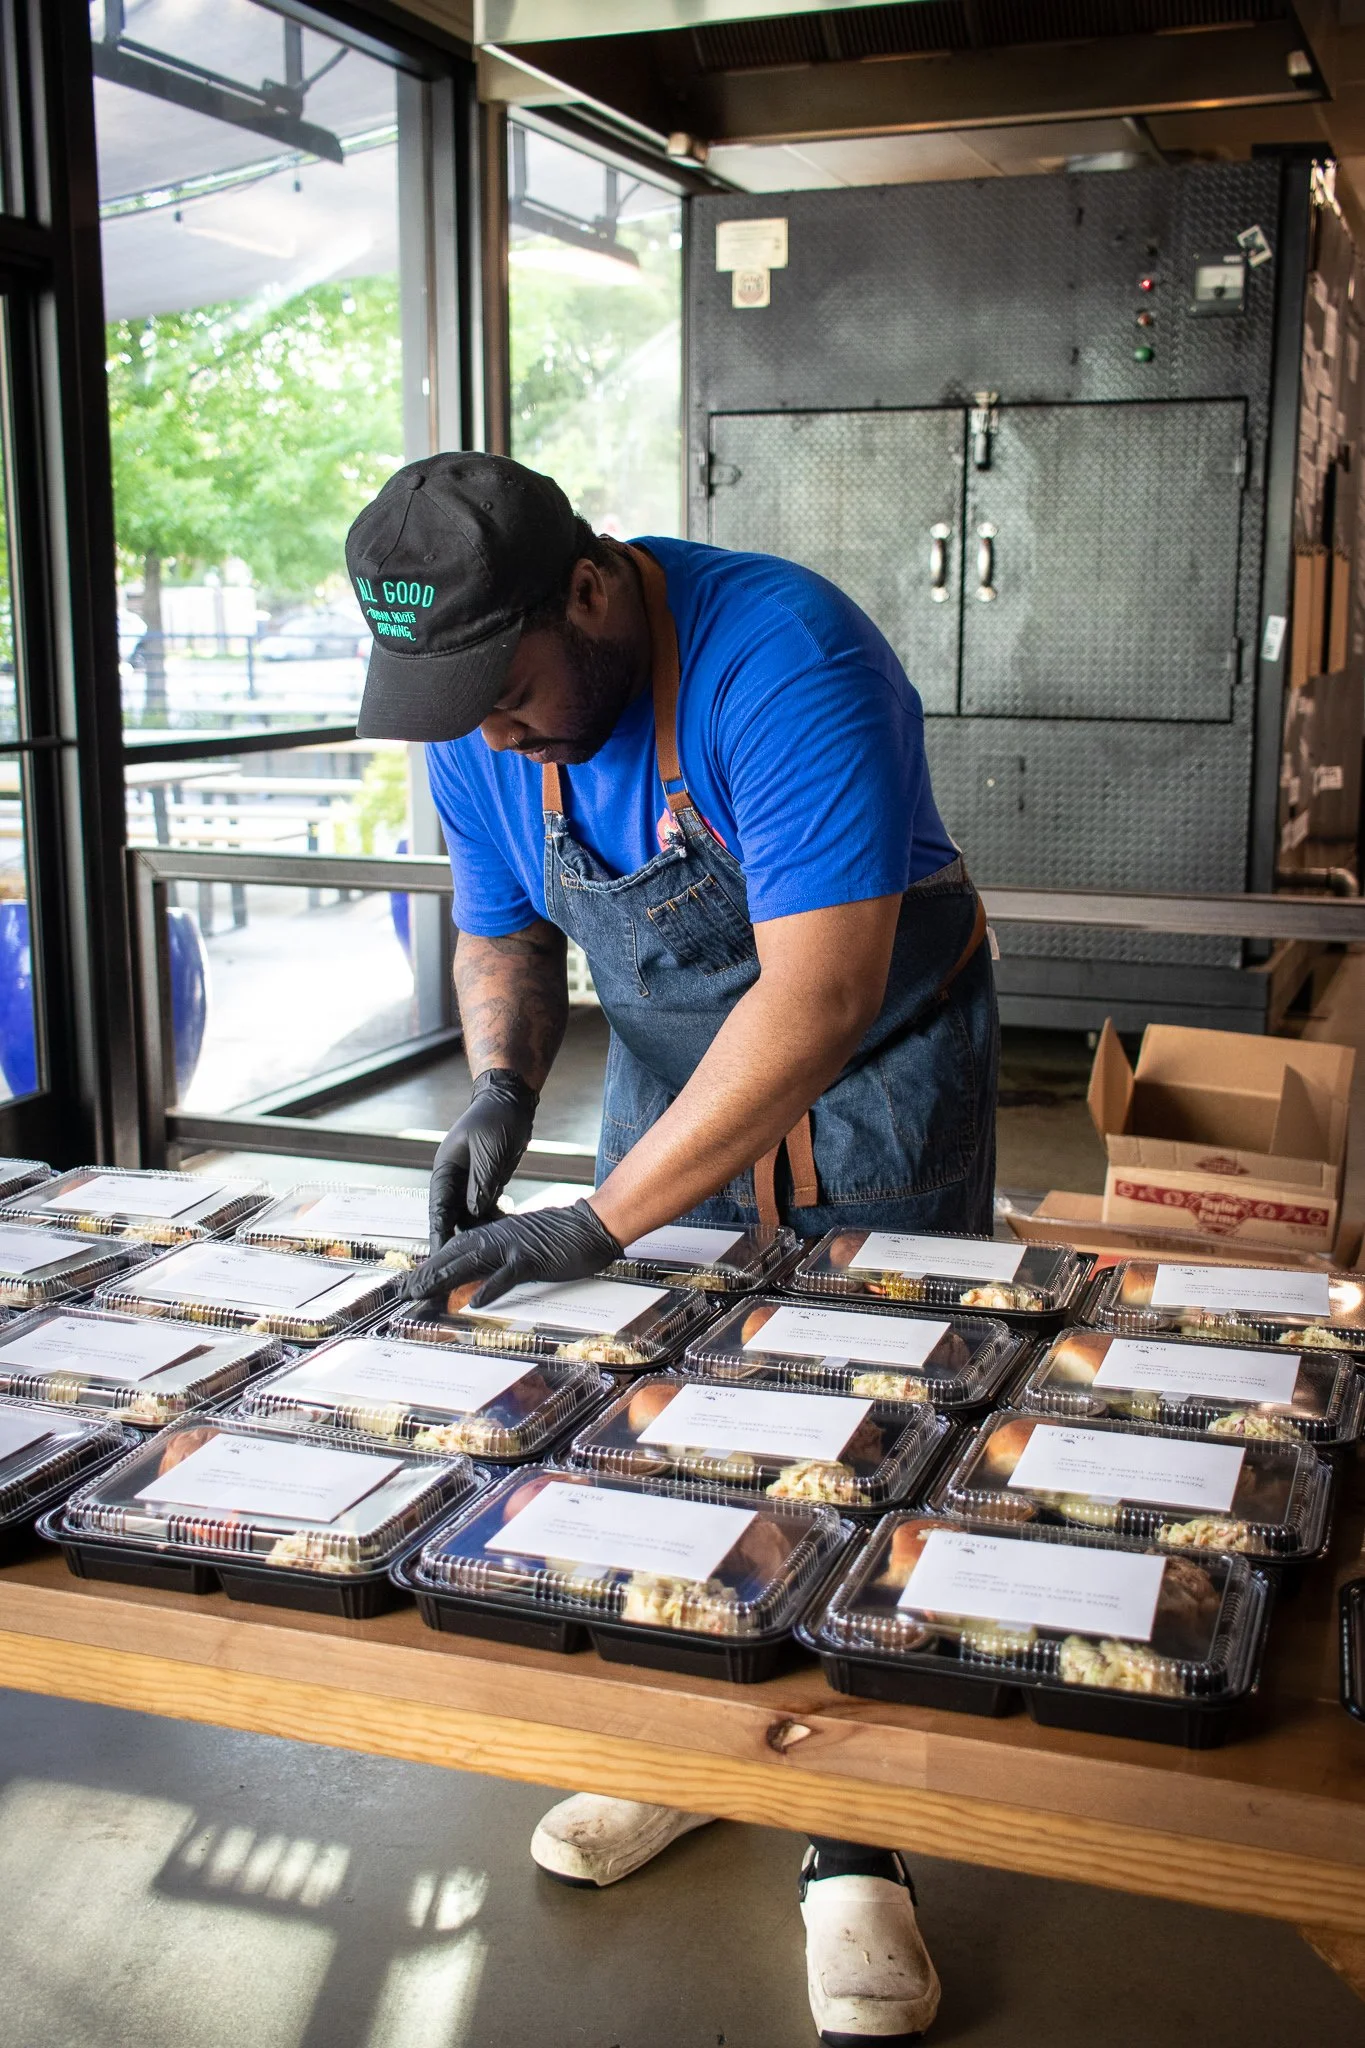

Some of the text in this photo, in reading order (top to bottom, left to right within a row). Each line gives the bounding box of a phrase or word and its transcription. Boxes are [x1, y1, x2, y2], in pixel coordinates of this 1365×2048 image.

[356, 576, 435, 608] ALL GOOD
[391, 611, 416, 624] ROOTS
